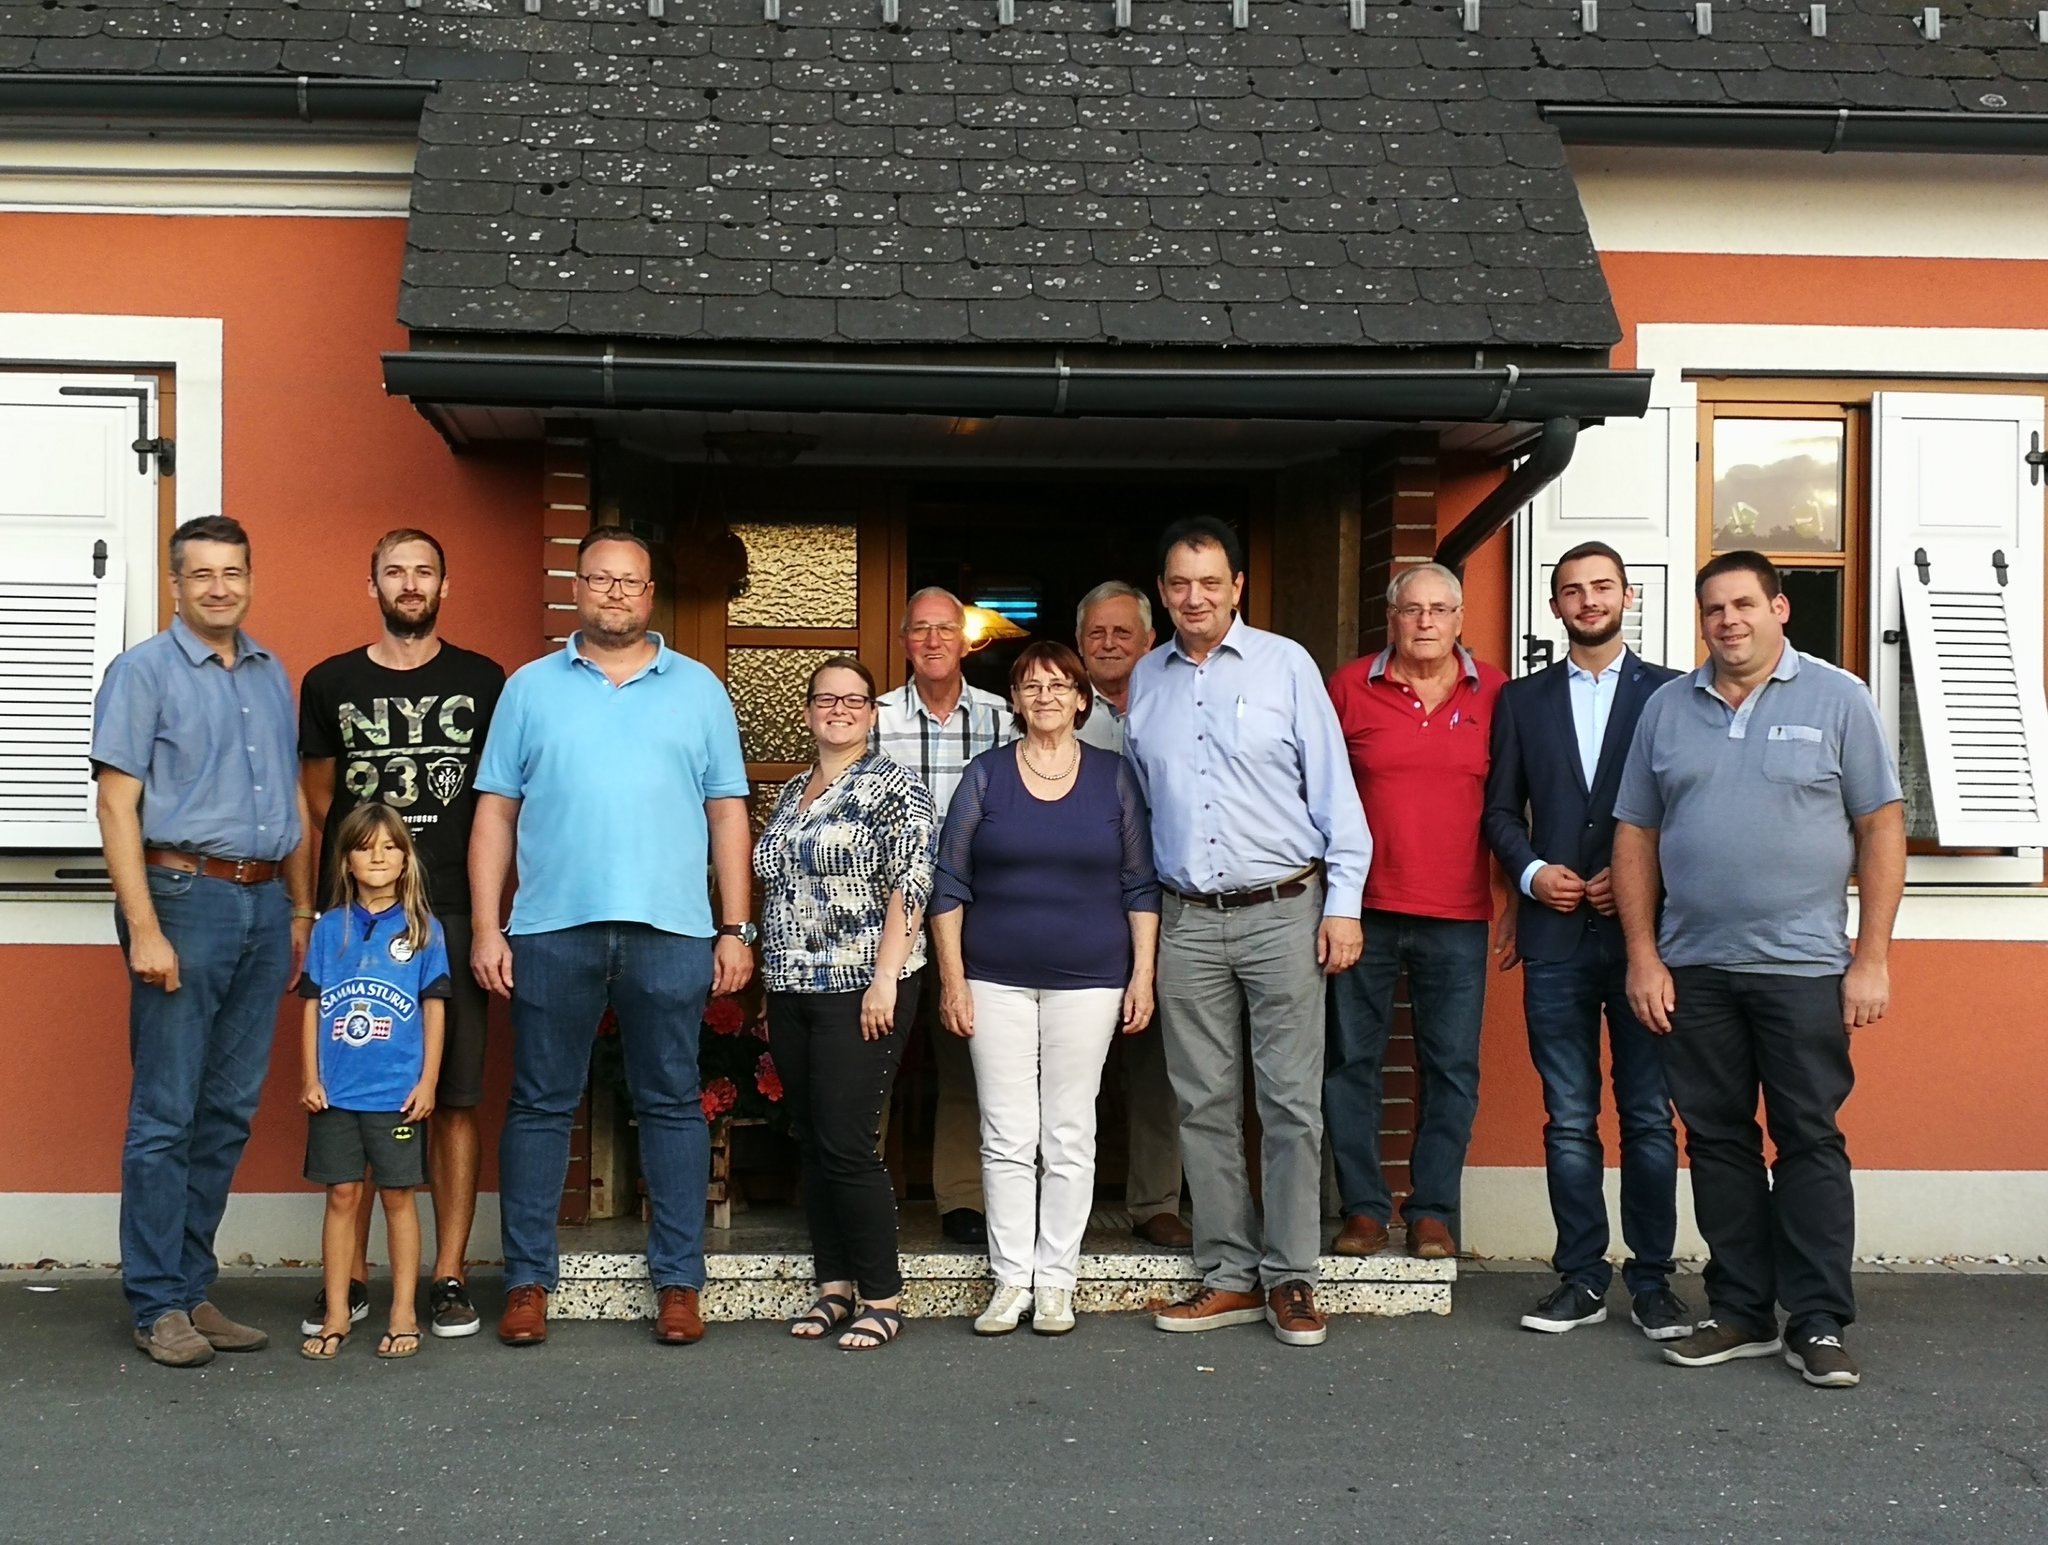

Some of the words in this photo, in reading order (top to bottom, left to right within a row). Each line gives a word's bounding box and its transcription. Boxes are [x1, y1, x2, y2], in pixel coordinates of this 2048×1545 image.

[338, 694, 475, 748] NYC
[345, 756, 420, 808] 93
[367, 983, 412, 1014] STURM
